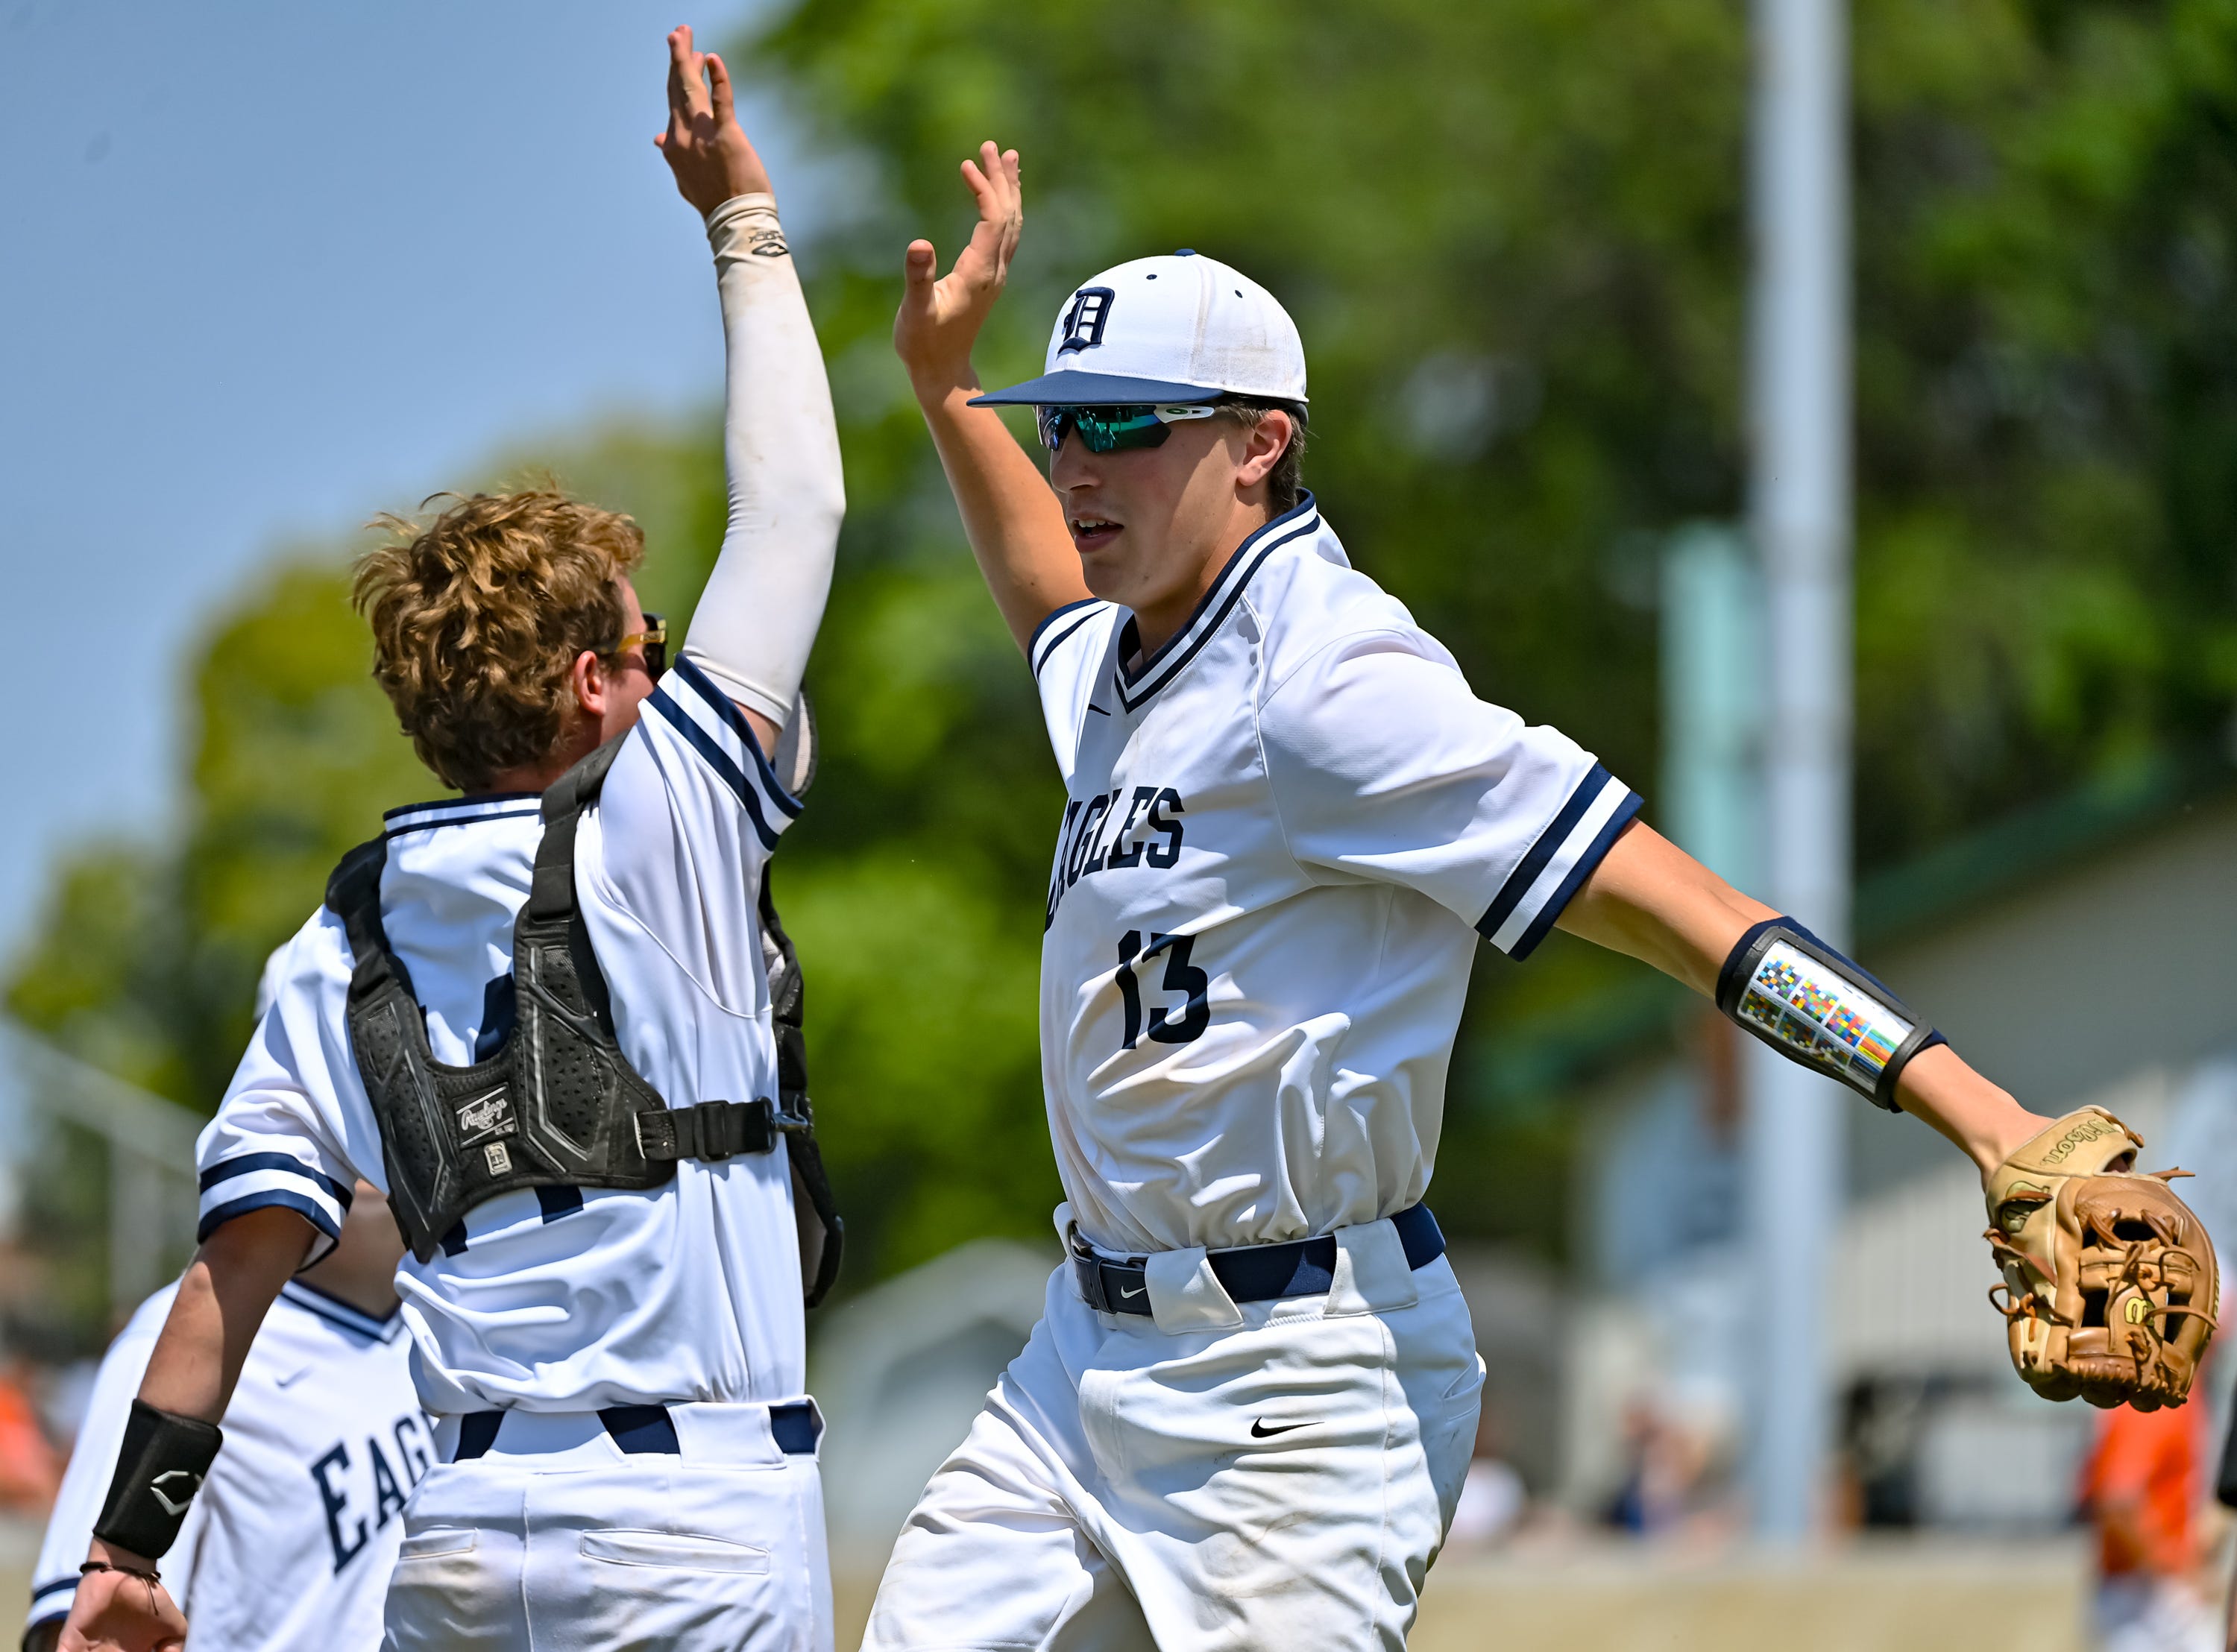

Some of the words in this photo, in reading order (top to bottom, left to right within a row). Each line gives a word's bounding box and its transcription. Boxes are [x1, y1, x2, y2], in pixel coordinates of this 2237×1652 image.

[1057, 286, 1116, 353] D
[1045, 786, 1185, 934] AGLES
[1116, 930, 1211, 1050] 13
[2042, 1119, 2121, 1164] Wilson
